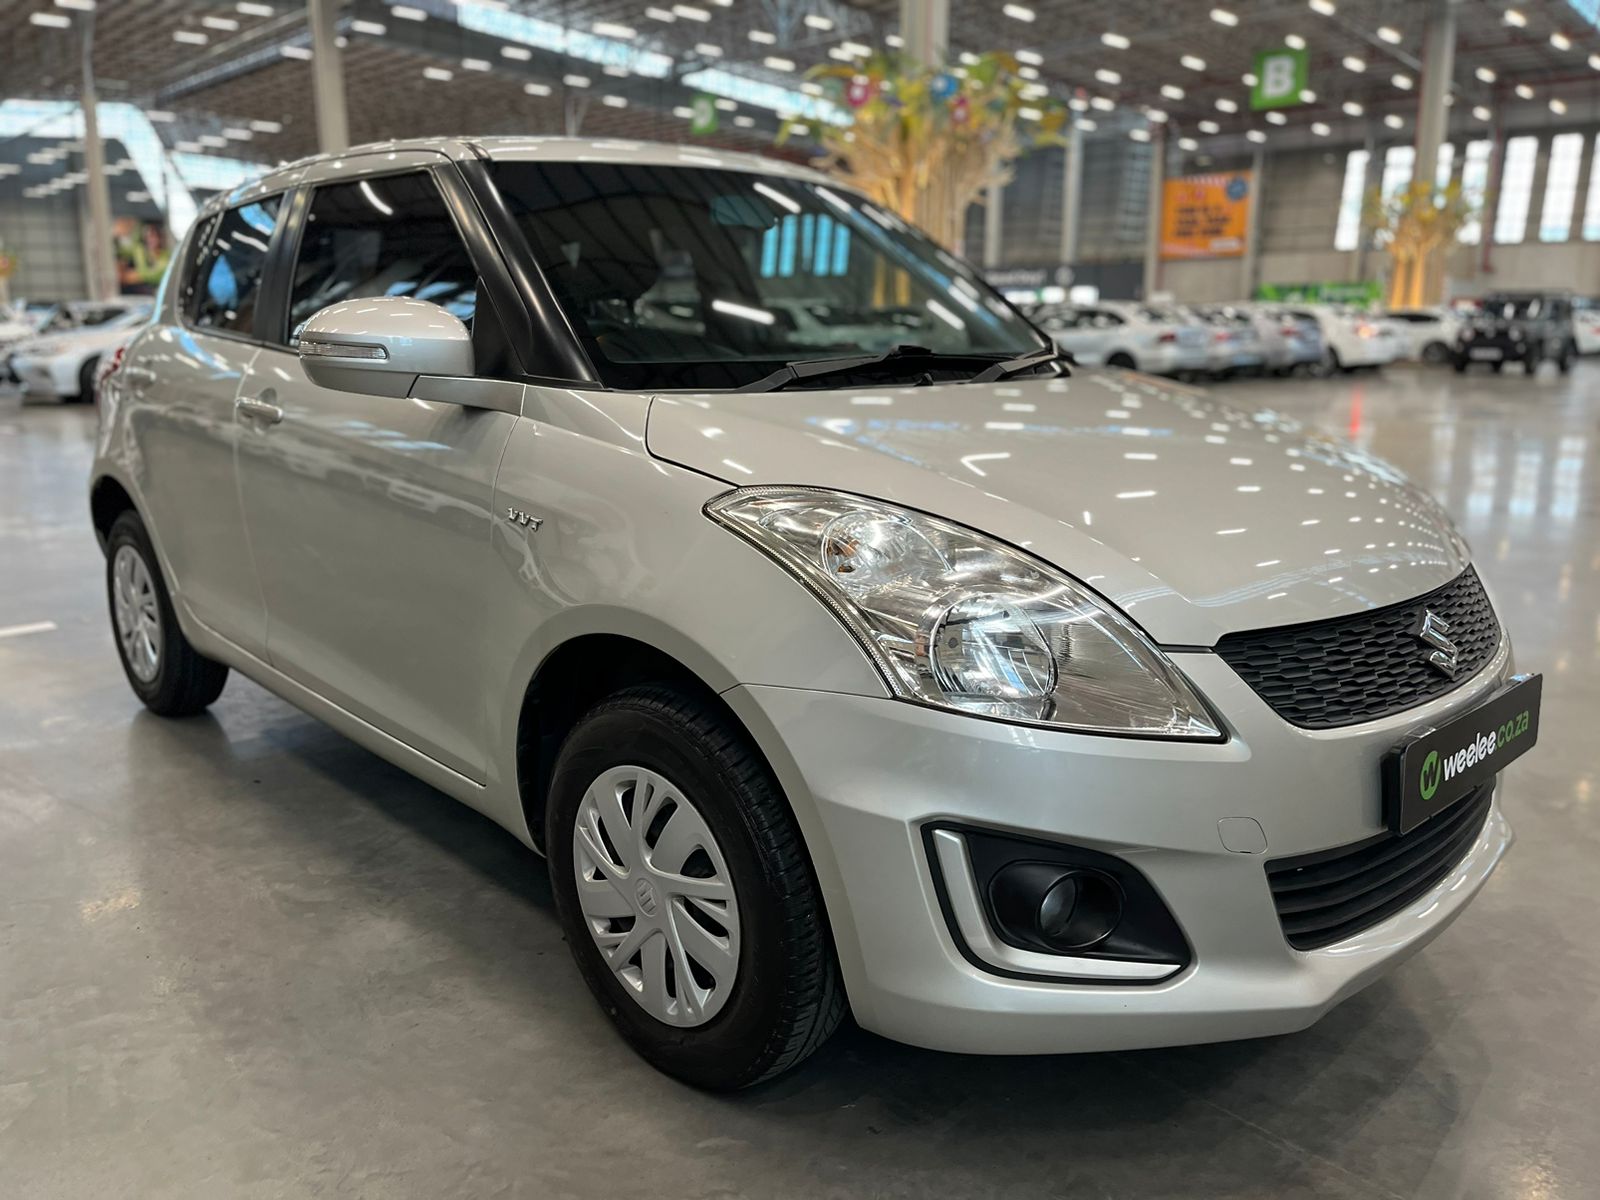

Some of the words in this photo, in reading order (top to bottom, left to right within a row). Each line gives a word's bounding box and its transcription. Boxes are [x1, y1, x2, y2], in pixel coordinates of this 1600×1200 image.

[1262, 55, 1296, 97] B
[508, 507, 544, 532] VVT
[1443, 710, 1529, 781] weelee.co.za
